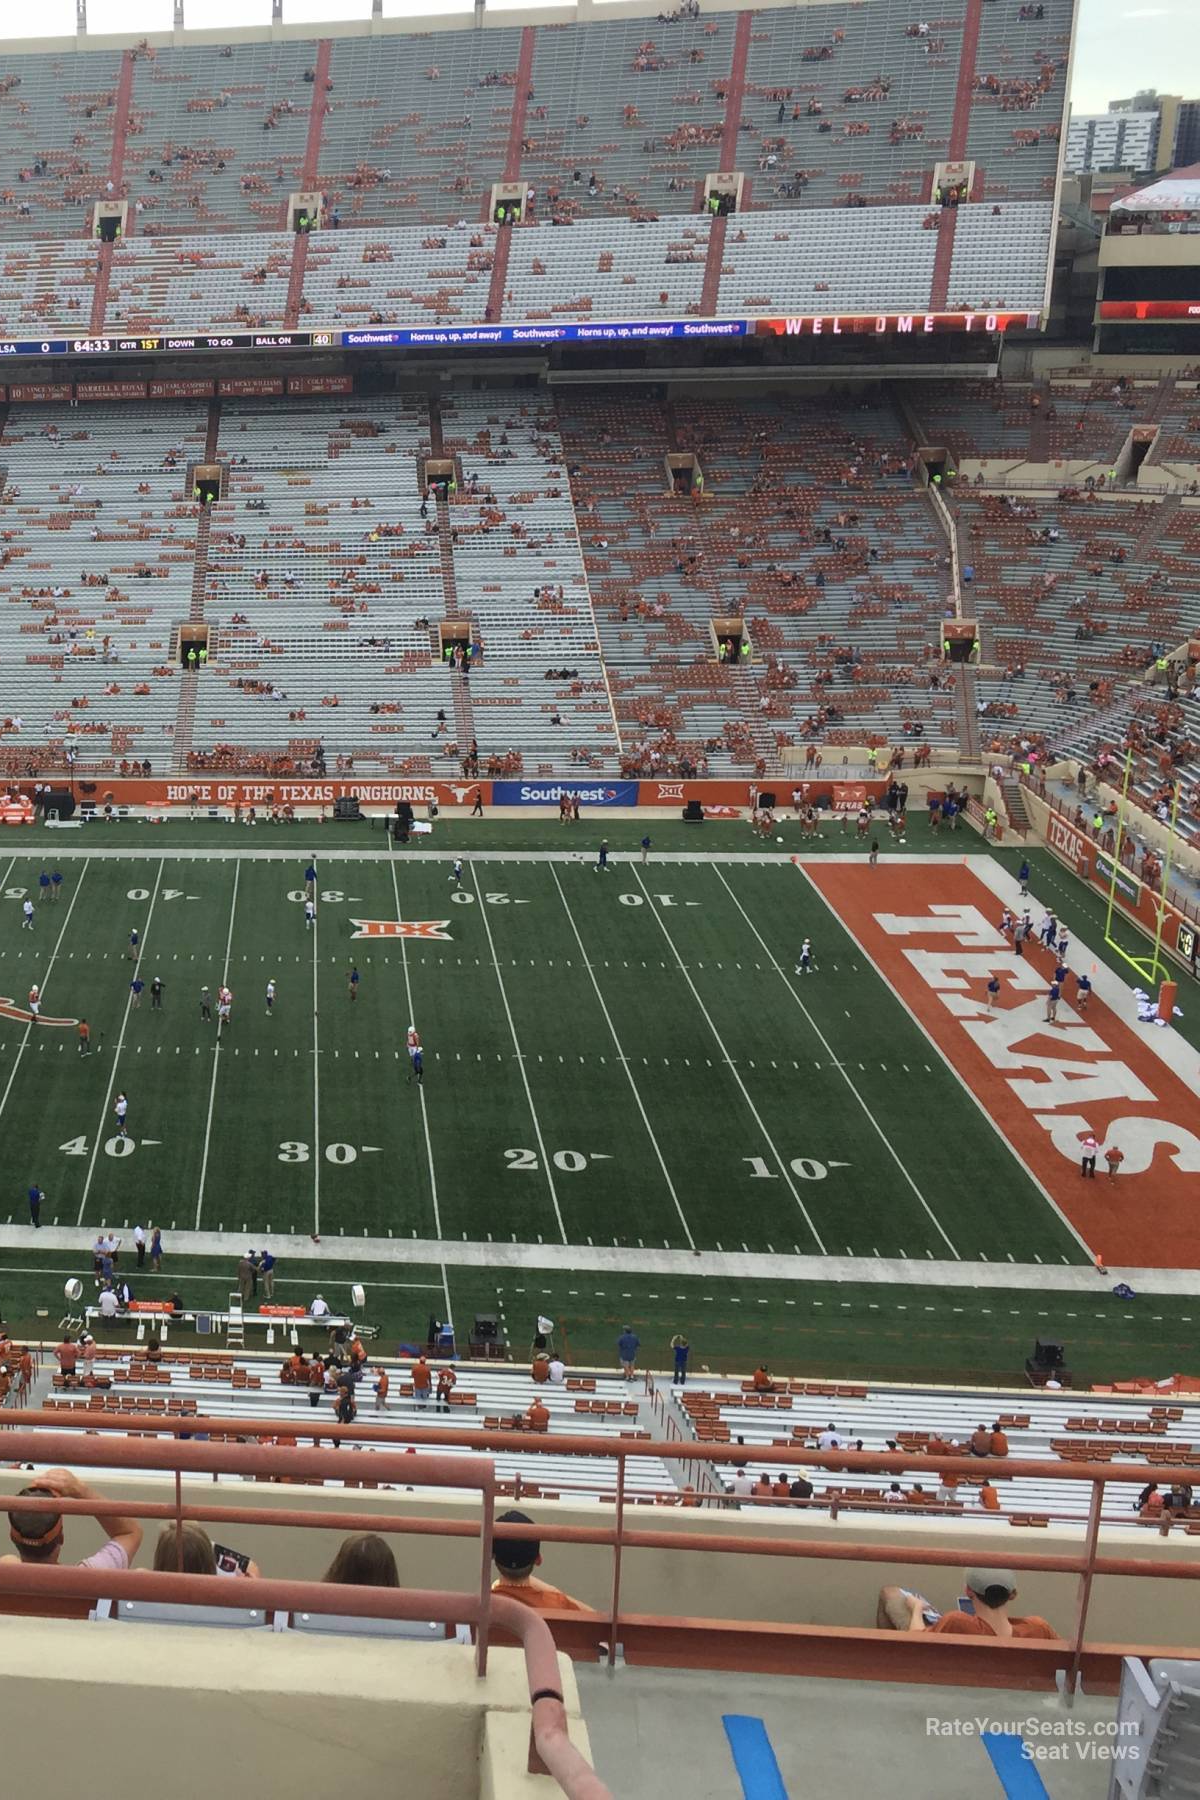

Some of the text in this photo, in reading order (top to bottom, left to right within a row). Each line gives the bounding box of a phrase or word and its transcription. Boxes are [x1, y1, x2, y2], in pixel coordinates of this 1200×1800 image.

[683, 324, 733, 334] Southwest
[965, 315, 997, 331] TO
[410, 331, 502, 343] Horns up, up, and away!
[512, 328, 560, 338] Southwest
[577, 326, 673, 338] Horns up, up, and away!
[140, 340, 160, 349] 1ST
[168, 340, 195, 348] DOWN
[255, 337, 277, 345] BALL
[314, 335, 329, 344] 40
[348, 333, 393, 344] Southwest
[41, 343, 50, 353] 0
[73, 340, 110, 352] 64:33
[152, 385, 163, 394] 20
[220, 383, 231, 392] 34
[290, 381, 300, 390] 12
[12, 389, 21, 398] 10
[218, 785, 237, 800] OF
[280, 785, 333, 800] TEXAS
[835, 801, 863, 810] TEXAS
[1050, 816, 1084, 863] TEXAS
[126, 887, 185, 901] 40
[450, 891, 510, 905] 20
[618, 893, 679, 906] 10
[872, 904, 1200, 1174] TEXAS
[58, 1135, 136, 1157] 40
[277, 1141, 357, 1164] 30
[503, 1149, 587, 1172] 20
[742, 1156, 828, 1181] 10
